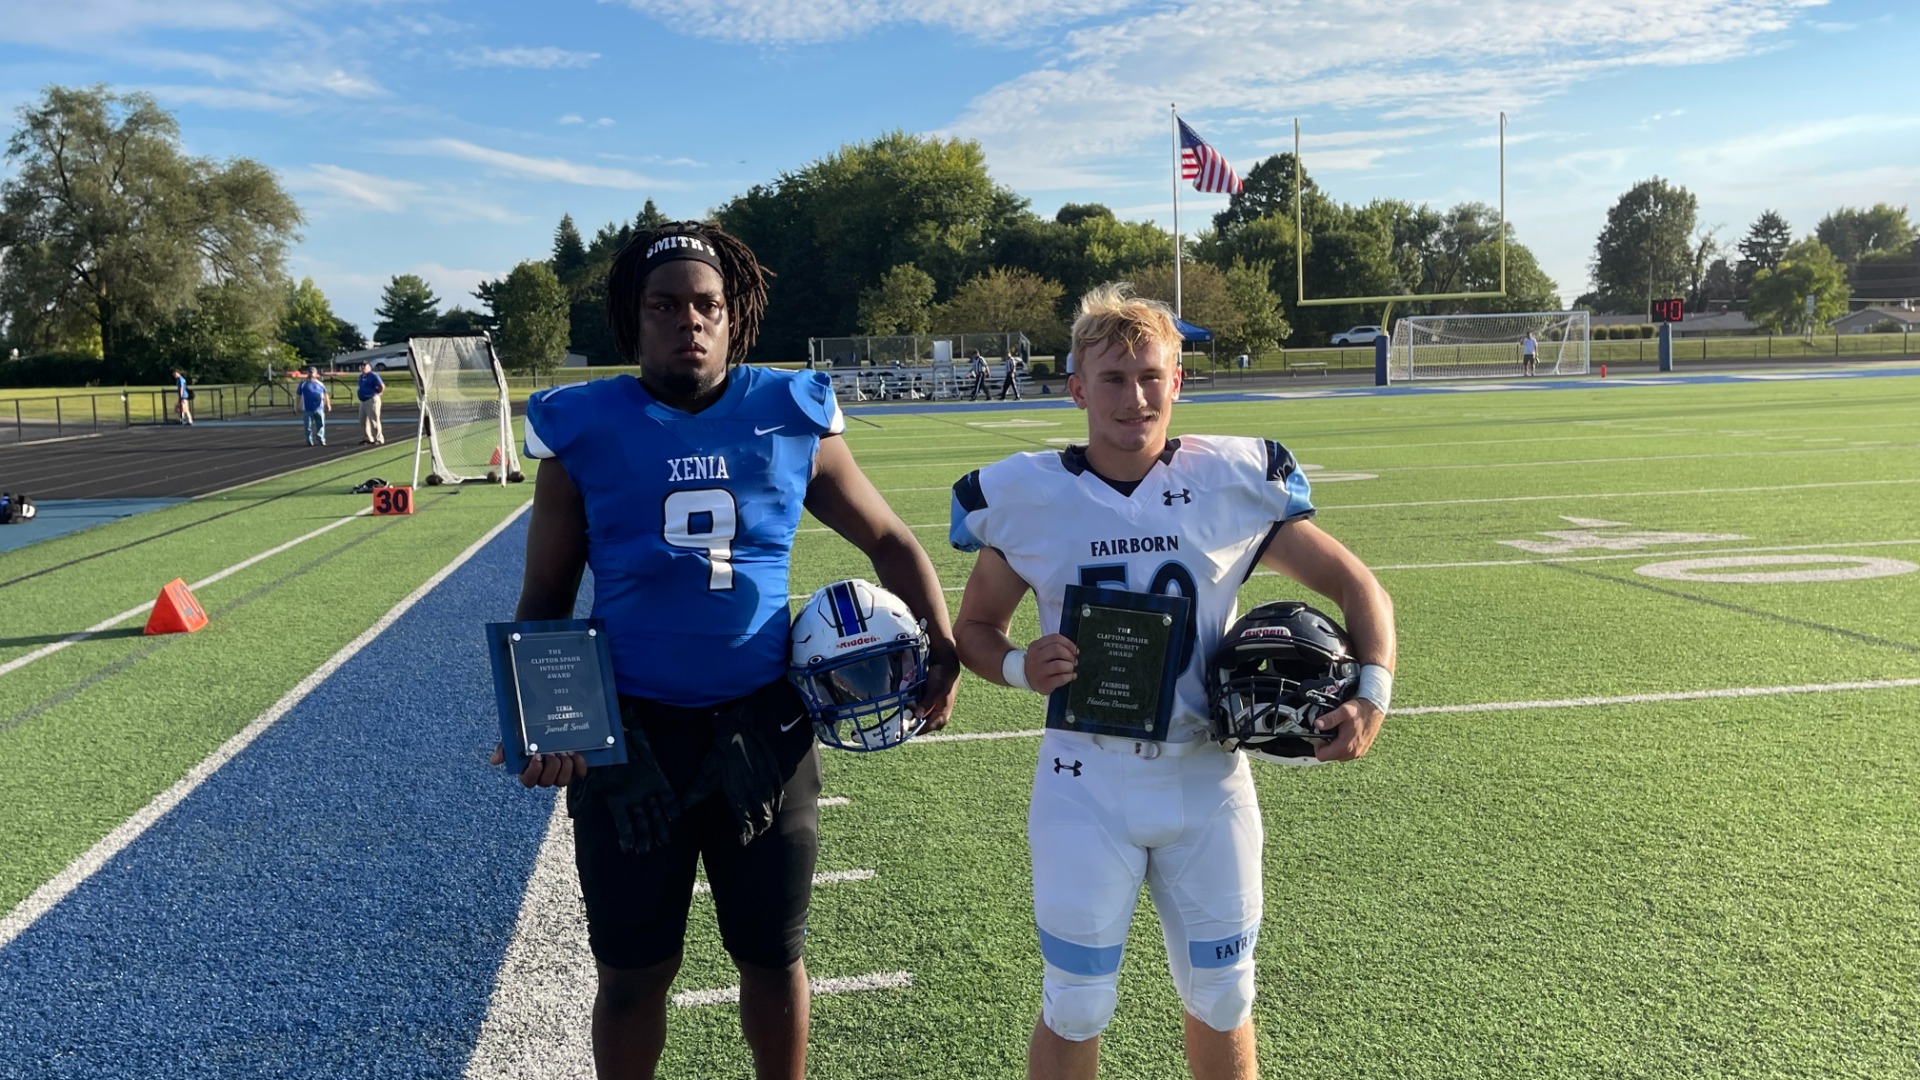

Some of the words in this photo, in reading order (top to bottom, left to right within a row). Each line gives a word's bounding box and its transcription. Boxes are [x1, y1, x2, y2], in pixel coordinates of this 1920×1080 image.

[1655, 301, 1682, 320] 40
[667, 456, 729, 481] XENIA
[376, 489, 409, 513] 30
[663, 487, 739, 591] 9
[1090, 535, 1179, 556] FAIRBORN
[1097, 633, 1125, 641] CLIFTON
[1104, 642, 1139, 650] INTEGRITY
[570, 722, 590, 731] Smith
